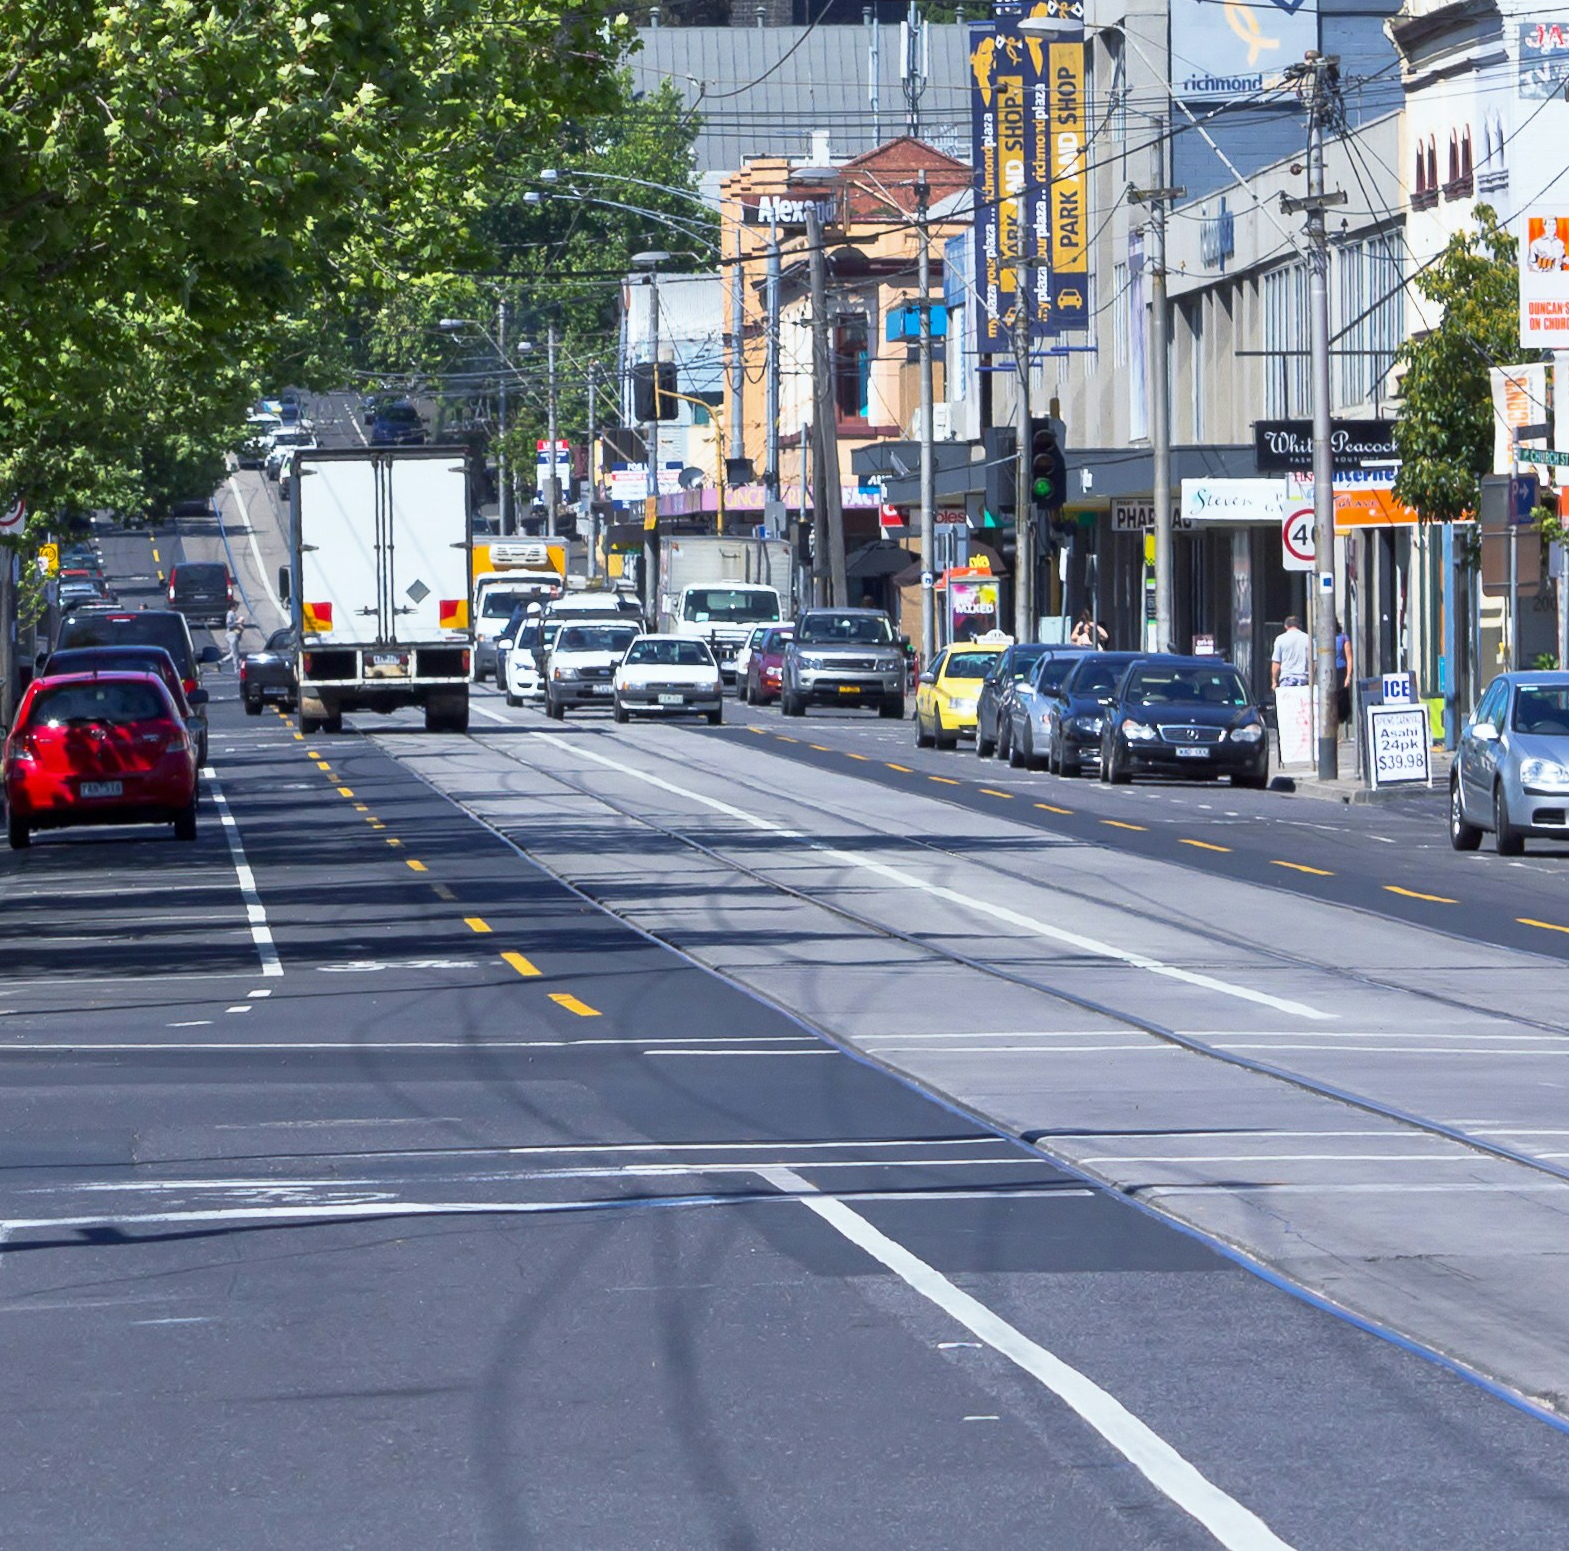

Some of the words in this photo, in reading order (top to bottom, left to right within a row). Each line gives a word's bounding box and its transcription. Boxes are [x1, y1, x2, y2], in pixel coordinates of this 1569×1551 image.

[1184, 74, 1263, 91] richmond
[1057, 65, 1079, 127] SHOP
[1003, 95, 1025, 152] SHOP
[1060, 189, 1081, 250] PARK
[1529, 317, 1541, 331] ON
[1264, 431, 1316, 454] Whit
[1531, 450, 1559, 463] CHURCH
[1560, 453, 1569, 465] ST
[1384, 681, 1409, 697] ICE
[1380, 728, 1418, 738] Asahi
[1381, 739, 1419, 752] 24pk
[1379, 754, 1424, 771] $39.98
